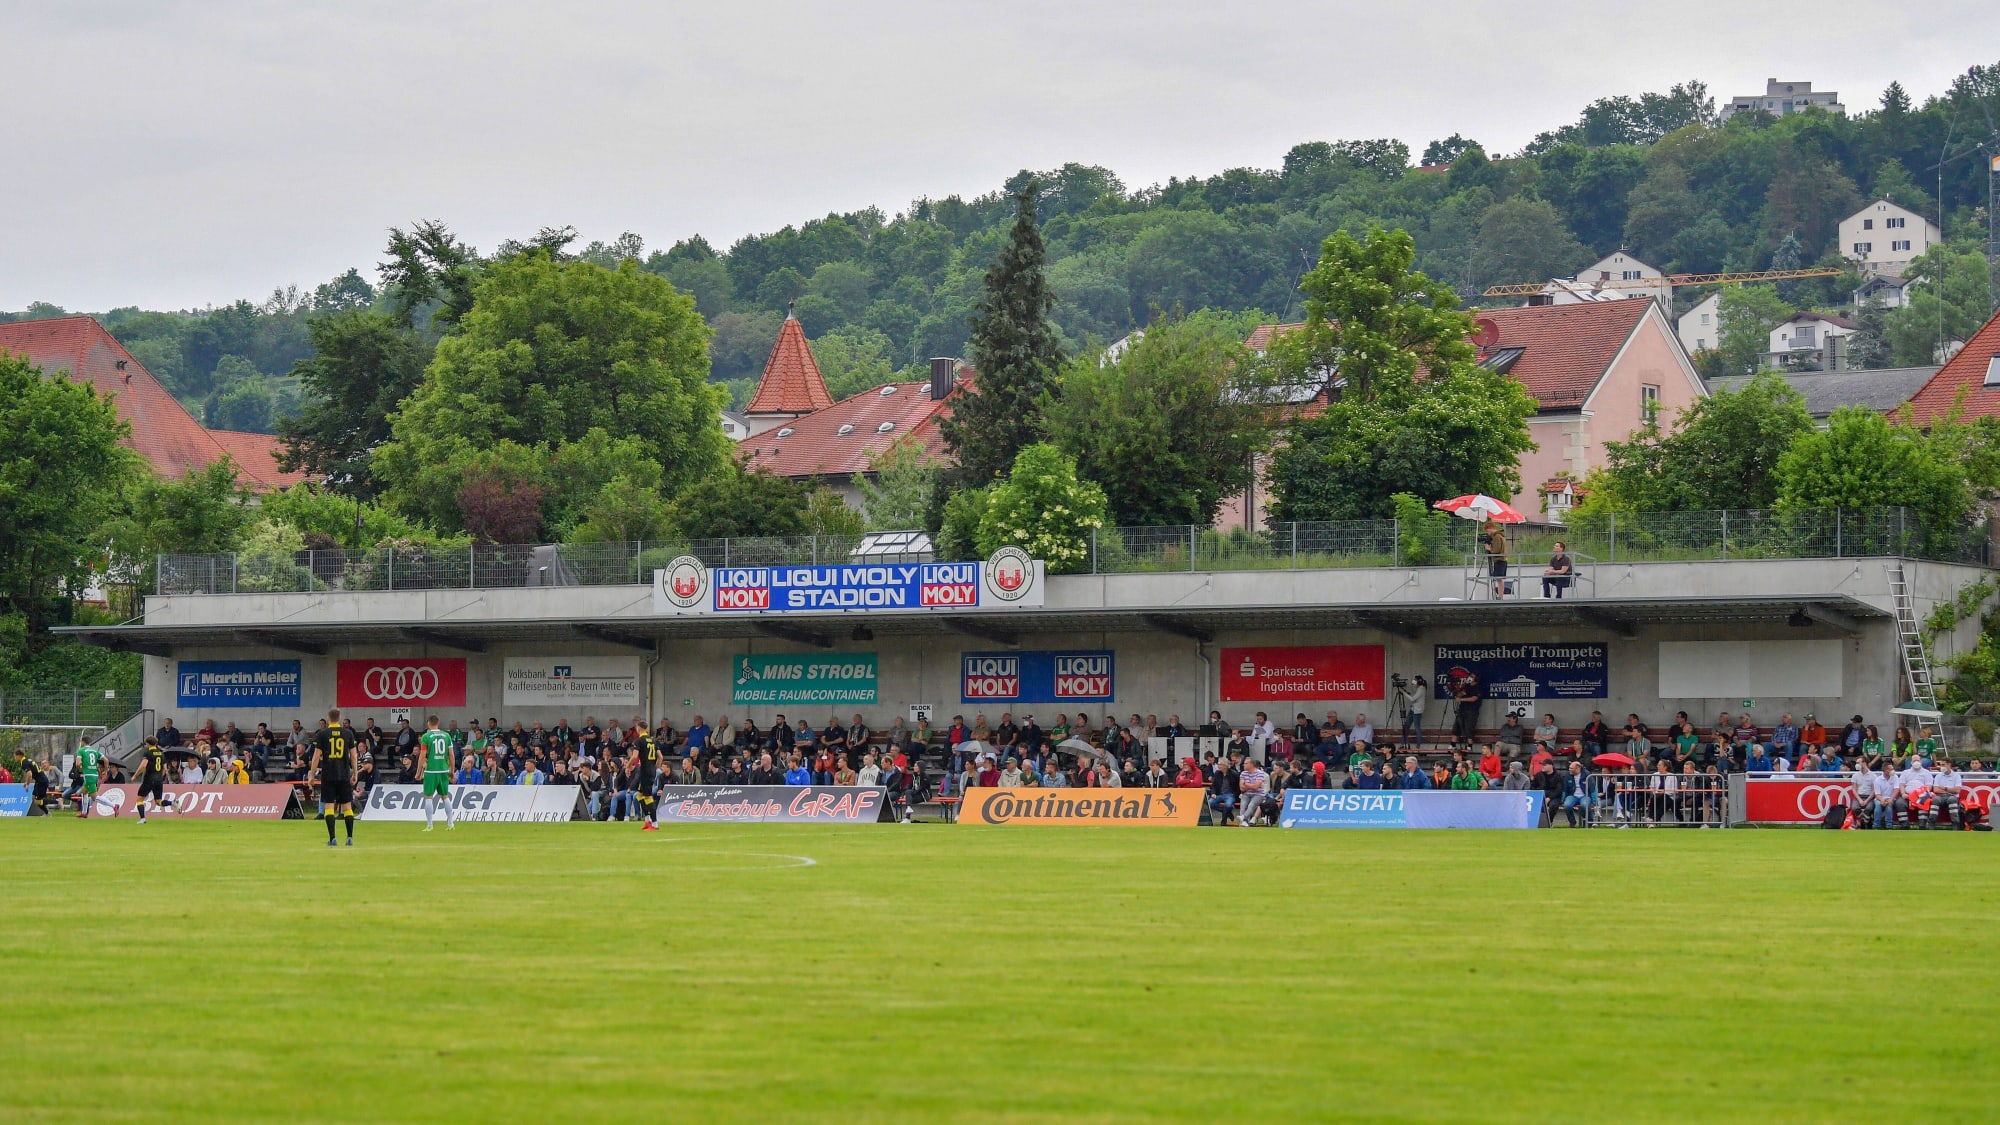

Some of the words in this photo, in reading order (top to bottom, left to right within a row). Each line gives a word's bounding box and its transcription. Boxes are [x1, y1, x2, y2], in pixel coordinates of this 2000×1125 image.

[719, 570, 767, 588] LIQUI
[772, 569, 837, 587] LIQUI
[843, 567, 918, 585] MOLY
[923, 565, 973, 584] LIQUI
[719, 588, 768, 607] MOLY
[787, 588, 906, 606] STADION
[923, 585, 974, 604] MOLY
[1437, 645, 1528, 661] Braugasthof
[1528, 645, 1602, 660] Trompete
[508, 669, 547, 679] Volksbank
[762, 664, 802, 680] MMS
[806, 663, 875, 679] STROBL
[968, 658, 1016, 676] LIQUI
[1058, 658, 1107, 676] LIQUI
[1260, 666, 1314, 679] Sparkasse
[201, 671, 252, 684] Martin
[254, 671, 297, 683] Meier
[1058, 677, 1108, 695] MOLY
[201, 687, 219, 696] DIE
[226, 686, 297, 696] BAUFAMILIE
[508, 681, 567, 691] Raiffeisenbank
[570, 681, 598, 692] Bayern
[600, 681, 621, 691] Mitte
[624, 682, 635, 691] eG
[734, 690, 776, 701] MOBILE
[778, 689, 875, 700] RAUMCONTAINER
[967, 678, 1017, 695] MOLY
[1260, 681, 1315, 694] Ingolstadt
[1318, 680, 1365, 691] Eichstätt
[396, 714, 405, 723] A
[1516, 707, 1526, 718] C
[328, 737, 345, 759] 19
[432, 738, 446, 754] 10
[647, 743, 656, 761] 21
[89, 753, 96, 765] 8
[155, 756, 161, 772] 8
[370, 786, 498, 814] templer
[665, 793, 680, 803] fair
[687, 791, 707, 799] sicher
[713, 788, 743, 800] gelassen
[788, 788, 880, 818] GRAF
[219, 805, 241, 814] UND
[242, 805, 280, 814] SPIELE.
[677, 799, 782, 817] Fahrschule
[981, 791, 1152, 824] Continental
[452, 811, 525, 822] ATURSTEIN
[532, 812, 568, 821] WERK
